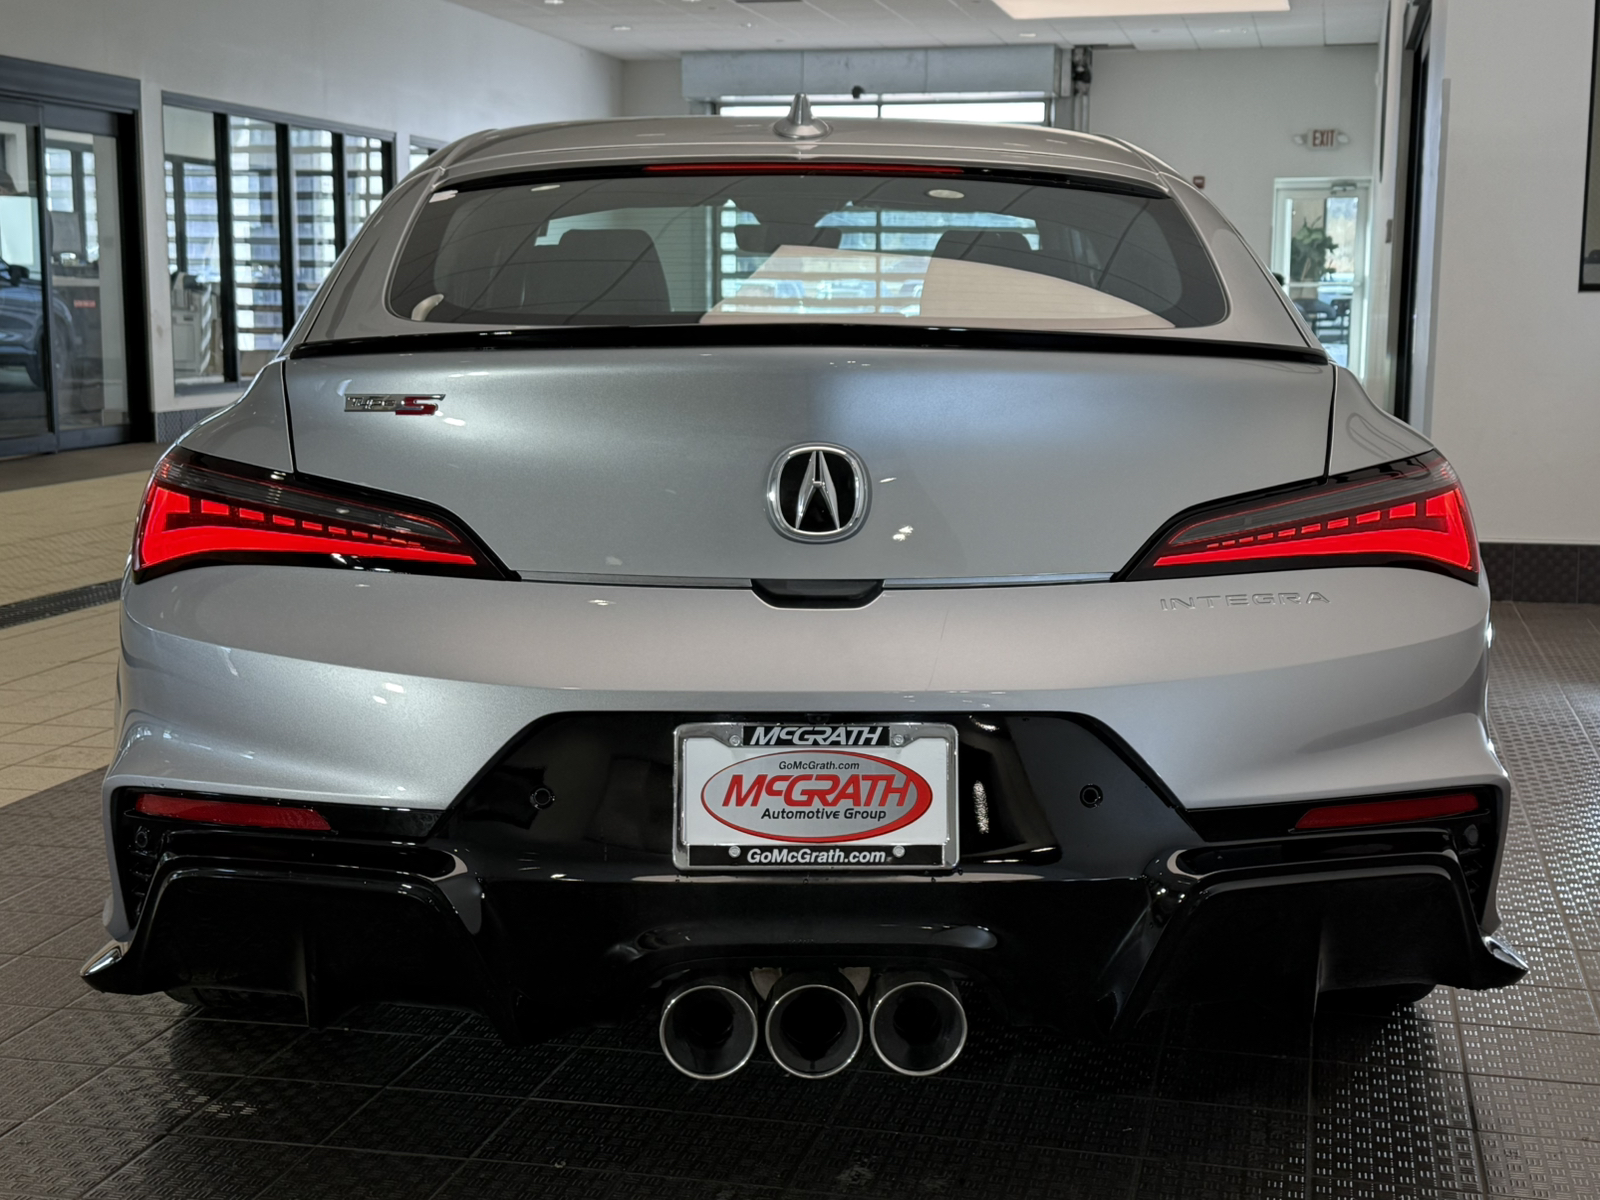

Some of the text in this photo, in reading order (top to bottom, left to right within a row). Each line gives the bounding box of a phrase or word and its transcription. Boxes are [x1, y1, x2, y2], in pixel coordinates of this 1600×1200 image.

[1312, 129, 1336, 147] EXIT
[395, 394, 446, 416] S
[1159, 591, 1331, 611] INTEGRA
[778, 760, 860, 771] GoMcGrath.com
[760, 807, 887, 822] Automotive Group
[746, 848, 886, 864] GoMcGrath.com
